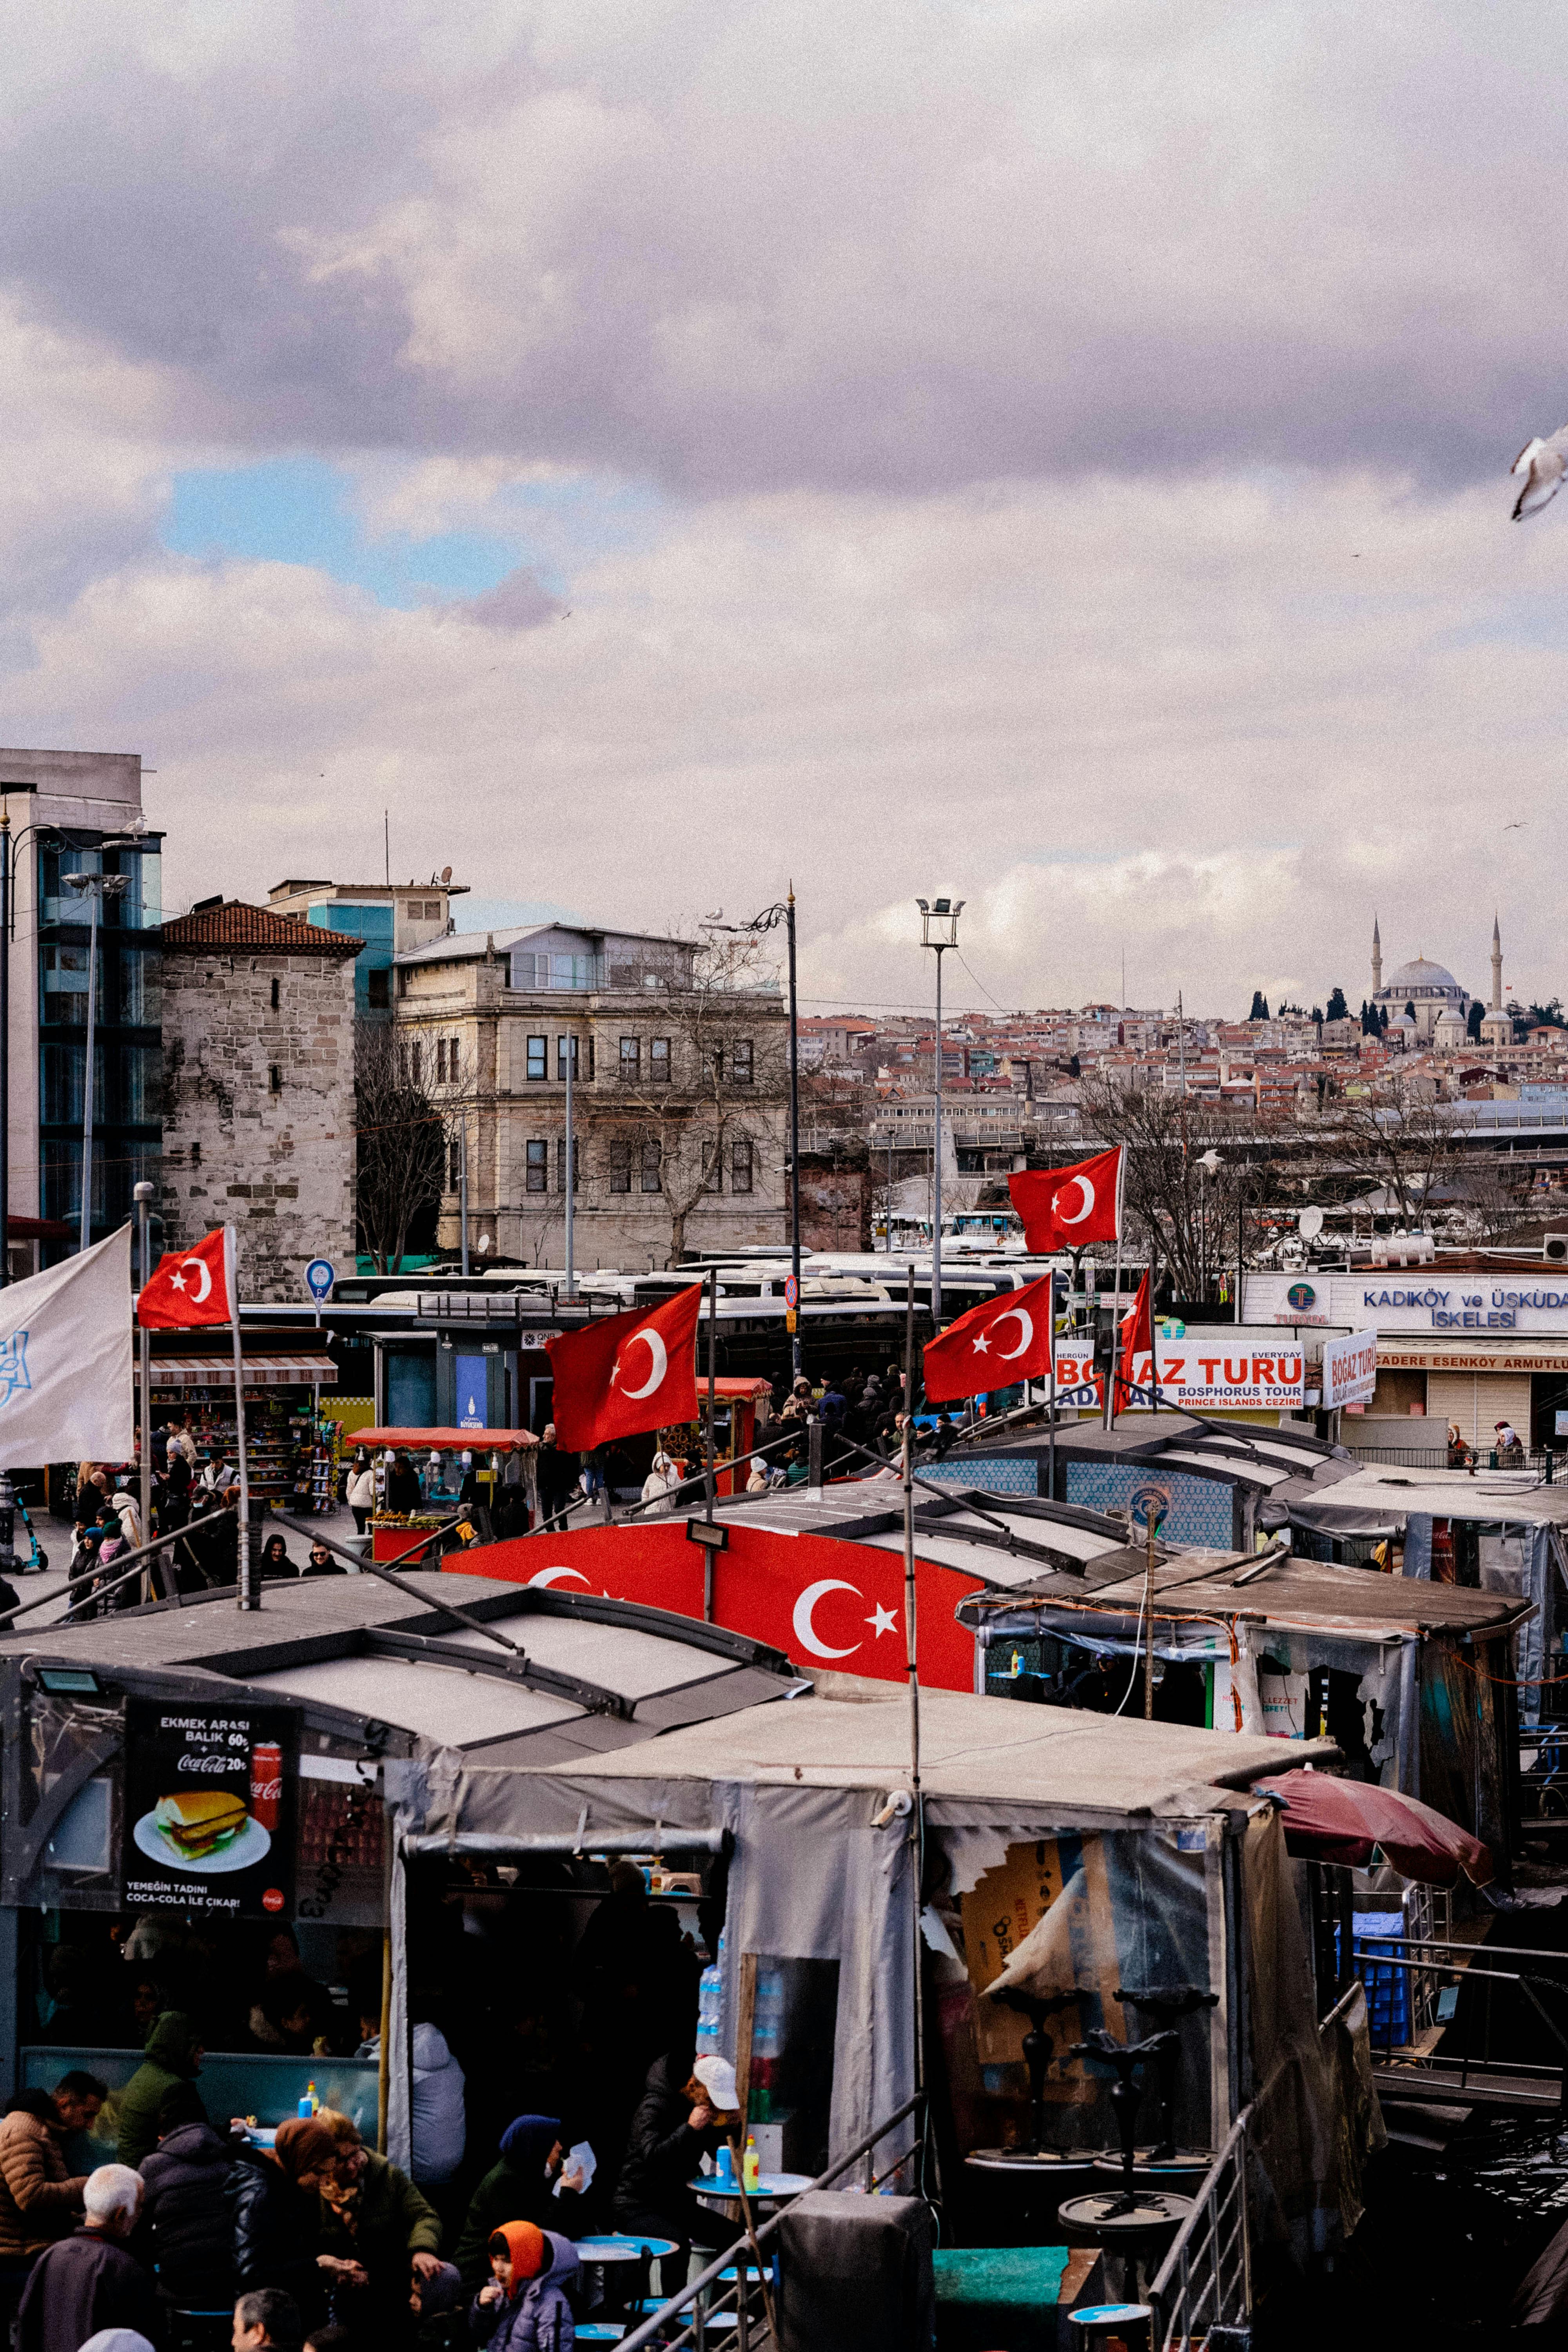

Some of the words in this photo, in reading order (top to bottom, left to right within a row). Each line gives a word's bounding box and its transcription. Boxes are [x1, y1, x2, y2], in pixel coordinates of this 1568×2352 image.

[317, 1288, 323, 1296] P
[1364, 1288, 1451, 1308] KADIKÖY
[1461, 1295, 1483, 1307] ve
[1274, 1314, 1329, 1325] TURYOL
[1432, 1309, 1517, 1328] İSKELESİ
[1332, 1350, 1356, 1387] BOĞAZ
[1358, 1346, 1376, 1377] TURU
[1433, 1357, 1497, 1368] ESENKÖY
[1504, 1359, 1568, 1369] ARMUTLU
[1198, 1358, 1301, 1385] TURU
[1178, 1387, 1260, 1396] BOSPHORUS
[1265, 1387, 1301, 1396] TOUR
[1265, 1397, 1302, 1406] CEZİRE
[161, 1717, 207, 1729] EKMEK
[209, 1719, 250, 1731] ARASI
[185, 1731, 224, 1742] BALIK
[127, 1881, 171, 1892] YEMEĞİN
[174, 1884, 208, 1894] TADINI
[126, 1893, 186, 1905] COCA-COLA
[188, 1895, 203, 1906] İLE
[205, 1898, 240, 1908] ÇIKAR!
